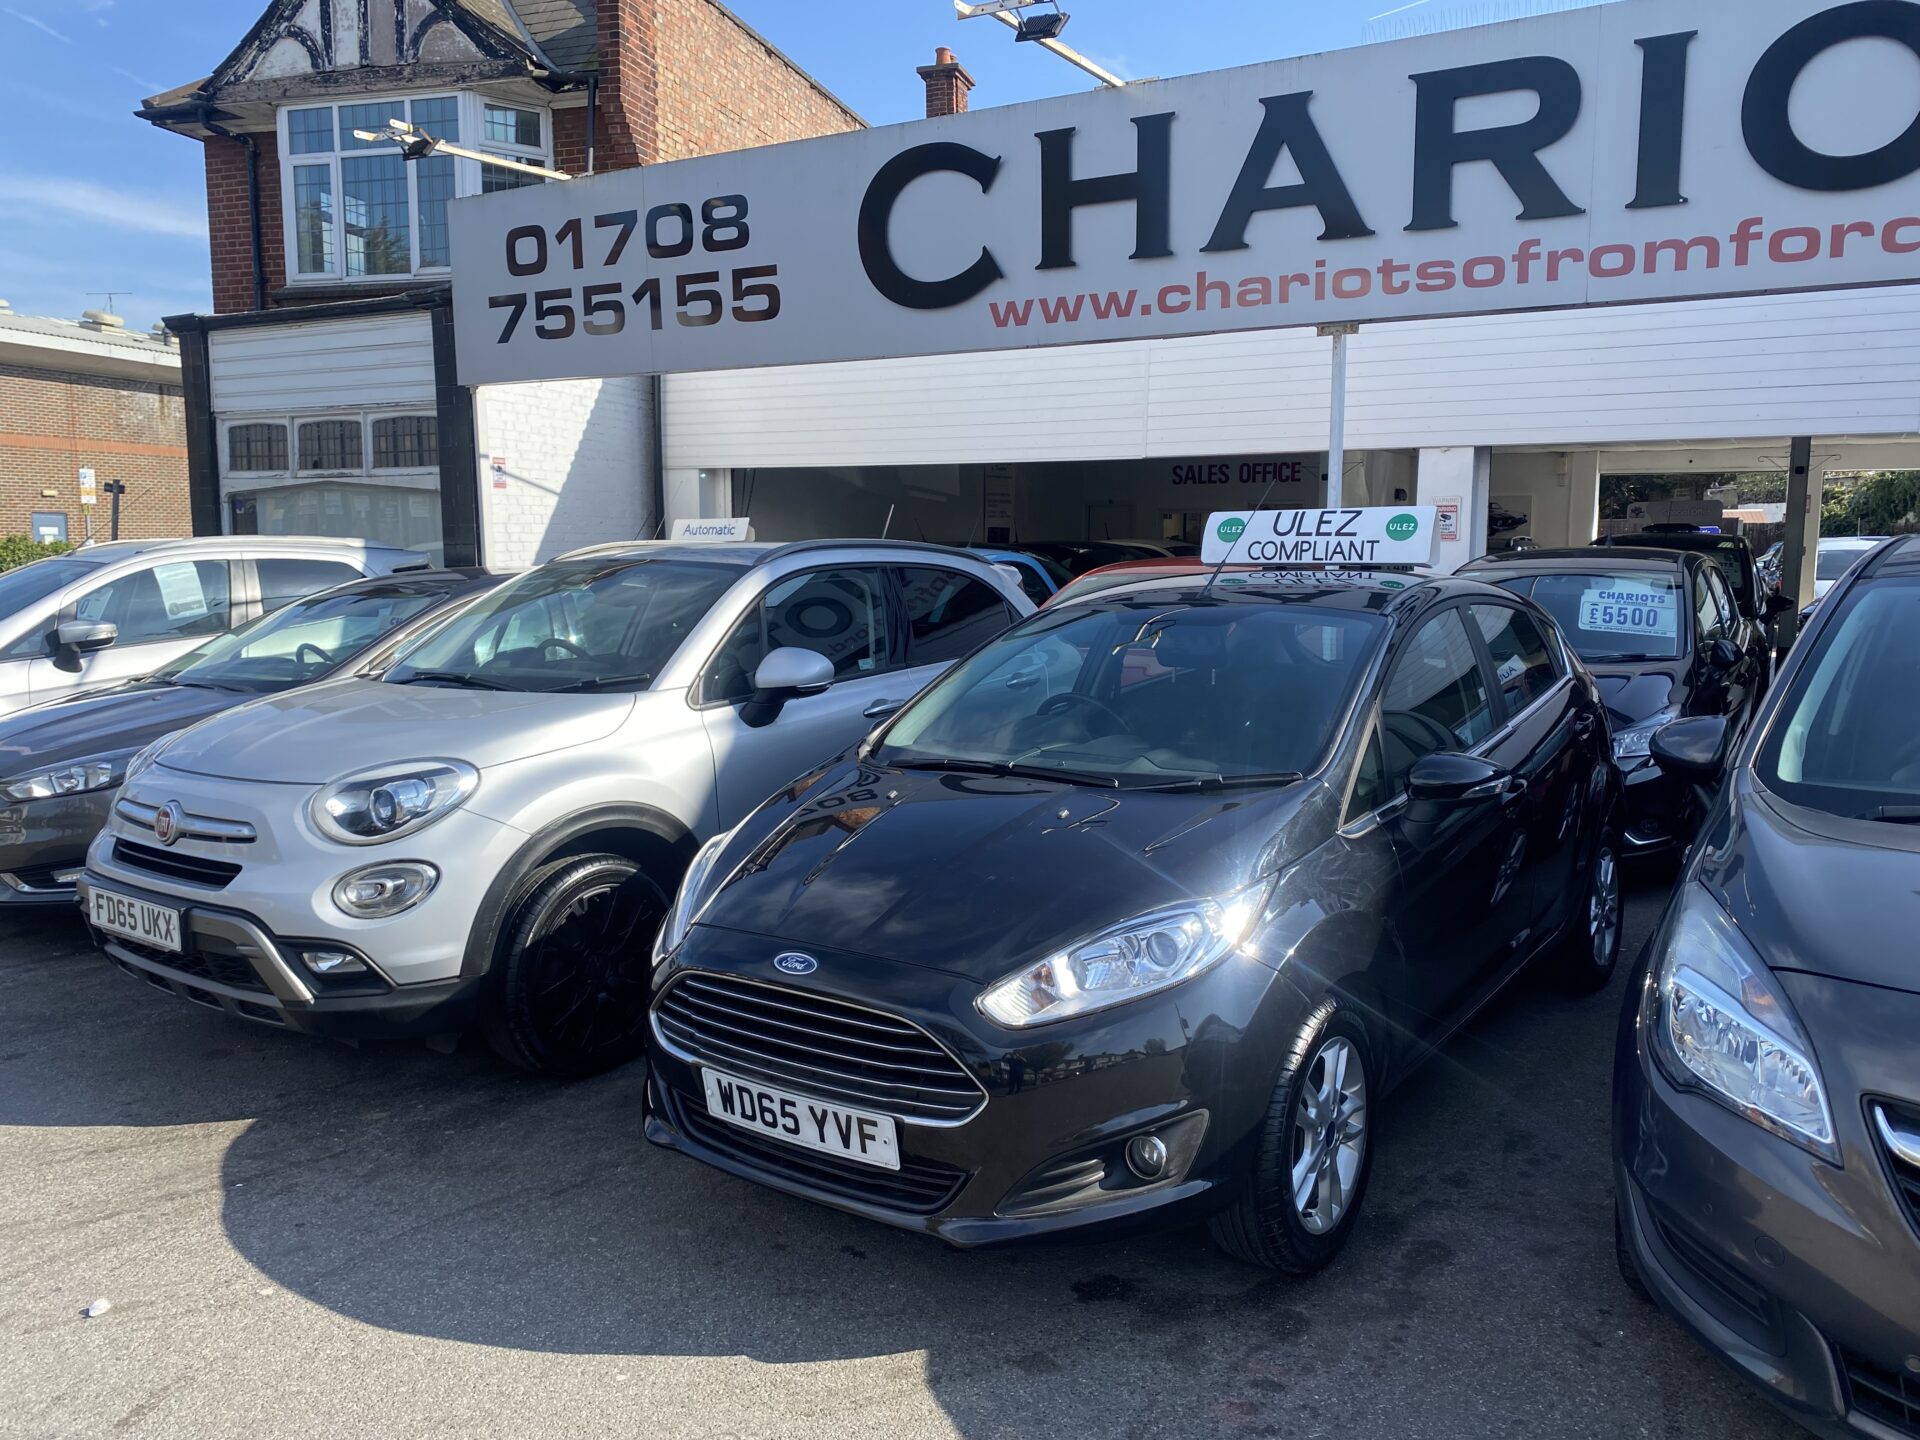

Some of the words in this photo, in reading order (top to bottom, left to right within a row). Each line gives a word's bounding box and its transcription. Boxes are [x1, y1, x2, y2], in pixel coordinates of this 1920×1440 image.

[857, 0, 1920, 309] CHARIO
[505, 194, 750, 277] 01708
[488, 264, 781, 344] 755155
[1172, 463, 1230, 485] SALES
[1239, 461, 1302, 483] OFFICE
[683, 524, 736, 536] Automatic
[1220, 525, 1243, 533] ULEZ
[1272, 510, 1363, 537] ULEZ
[1389, 523, 1415, 532] ULEZ
[1247, 540, 1380, 561] COMPLIANT
[1598, 591, 1666, 604] CHARIOTS
[95, 893, 138, 931] FD65
[140, 905, 174, 943] UKX
[781, 957, 809, 970] Ford
[716, 1078, 801, 1136] WD65
[808, 1105, 878, 1154] YVF
